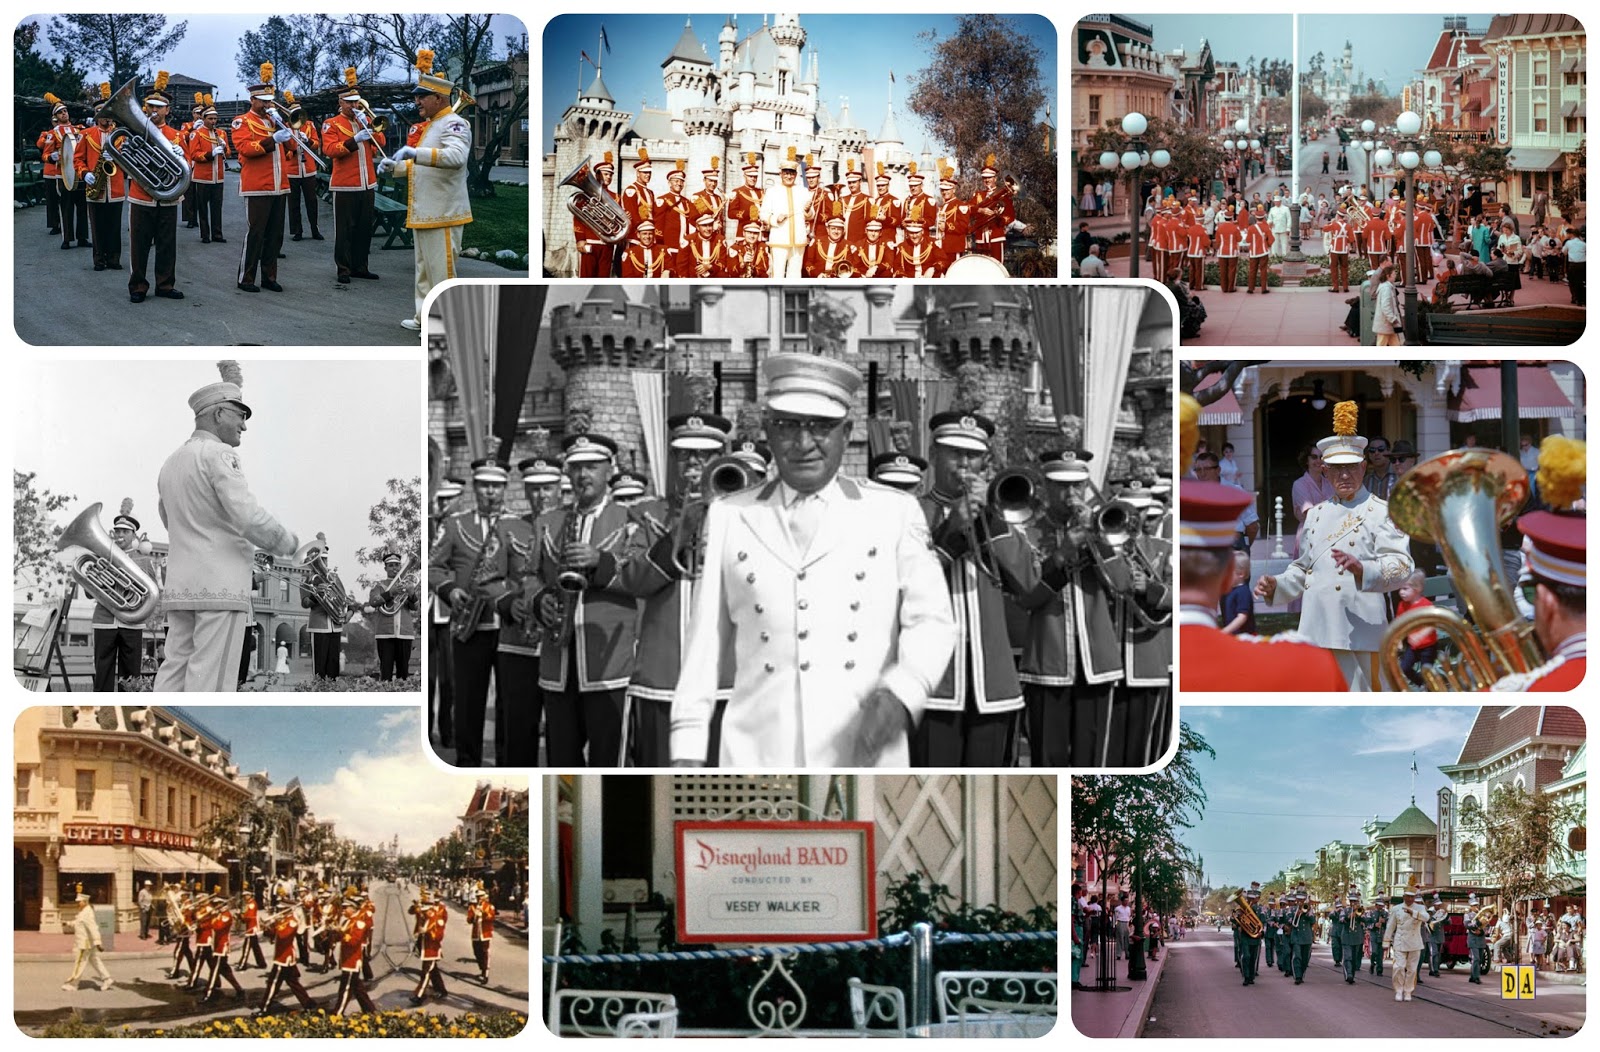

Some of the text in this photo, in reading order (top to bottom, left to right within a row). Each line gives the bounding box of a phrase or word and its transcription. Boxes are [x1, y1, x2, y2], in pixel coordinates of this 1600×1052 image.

[1499, 61, 1507, 140] WURLITZER
[67, 827, 124, 840] GIFTS
[1441, 793, 1449, 853] SWIFT
[695, 838, 848, 873] Disneyland BAND
[732, 876, 813, 884] CONDUCTED BY
[725, 901, 820, 912] VESEY WALKER
